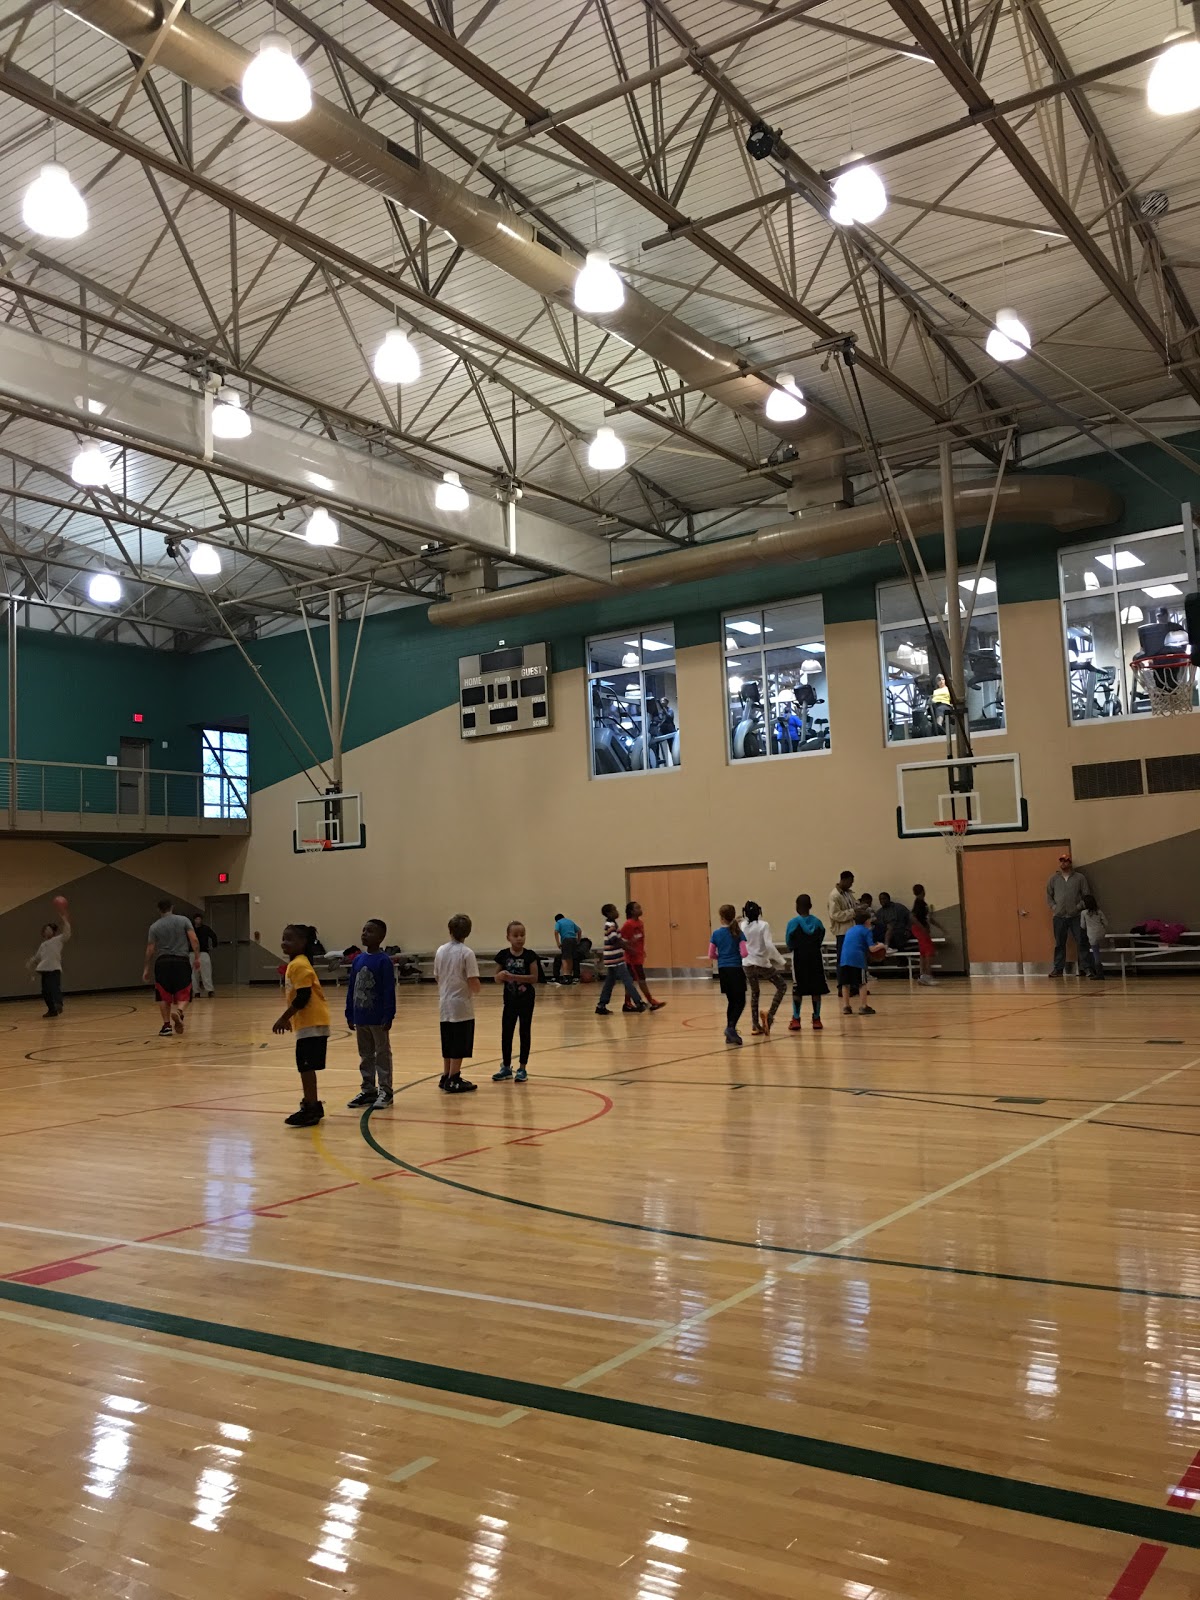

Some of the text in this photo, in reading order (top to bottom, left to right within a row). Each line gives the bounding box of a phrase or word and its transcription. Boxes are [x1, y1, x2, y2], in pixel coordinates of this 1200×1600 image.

[521, 666, 542, 676] GUEST
[464, 677, 482, 686] HOME
[488, 702, 504, 710] PLAYER
